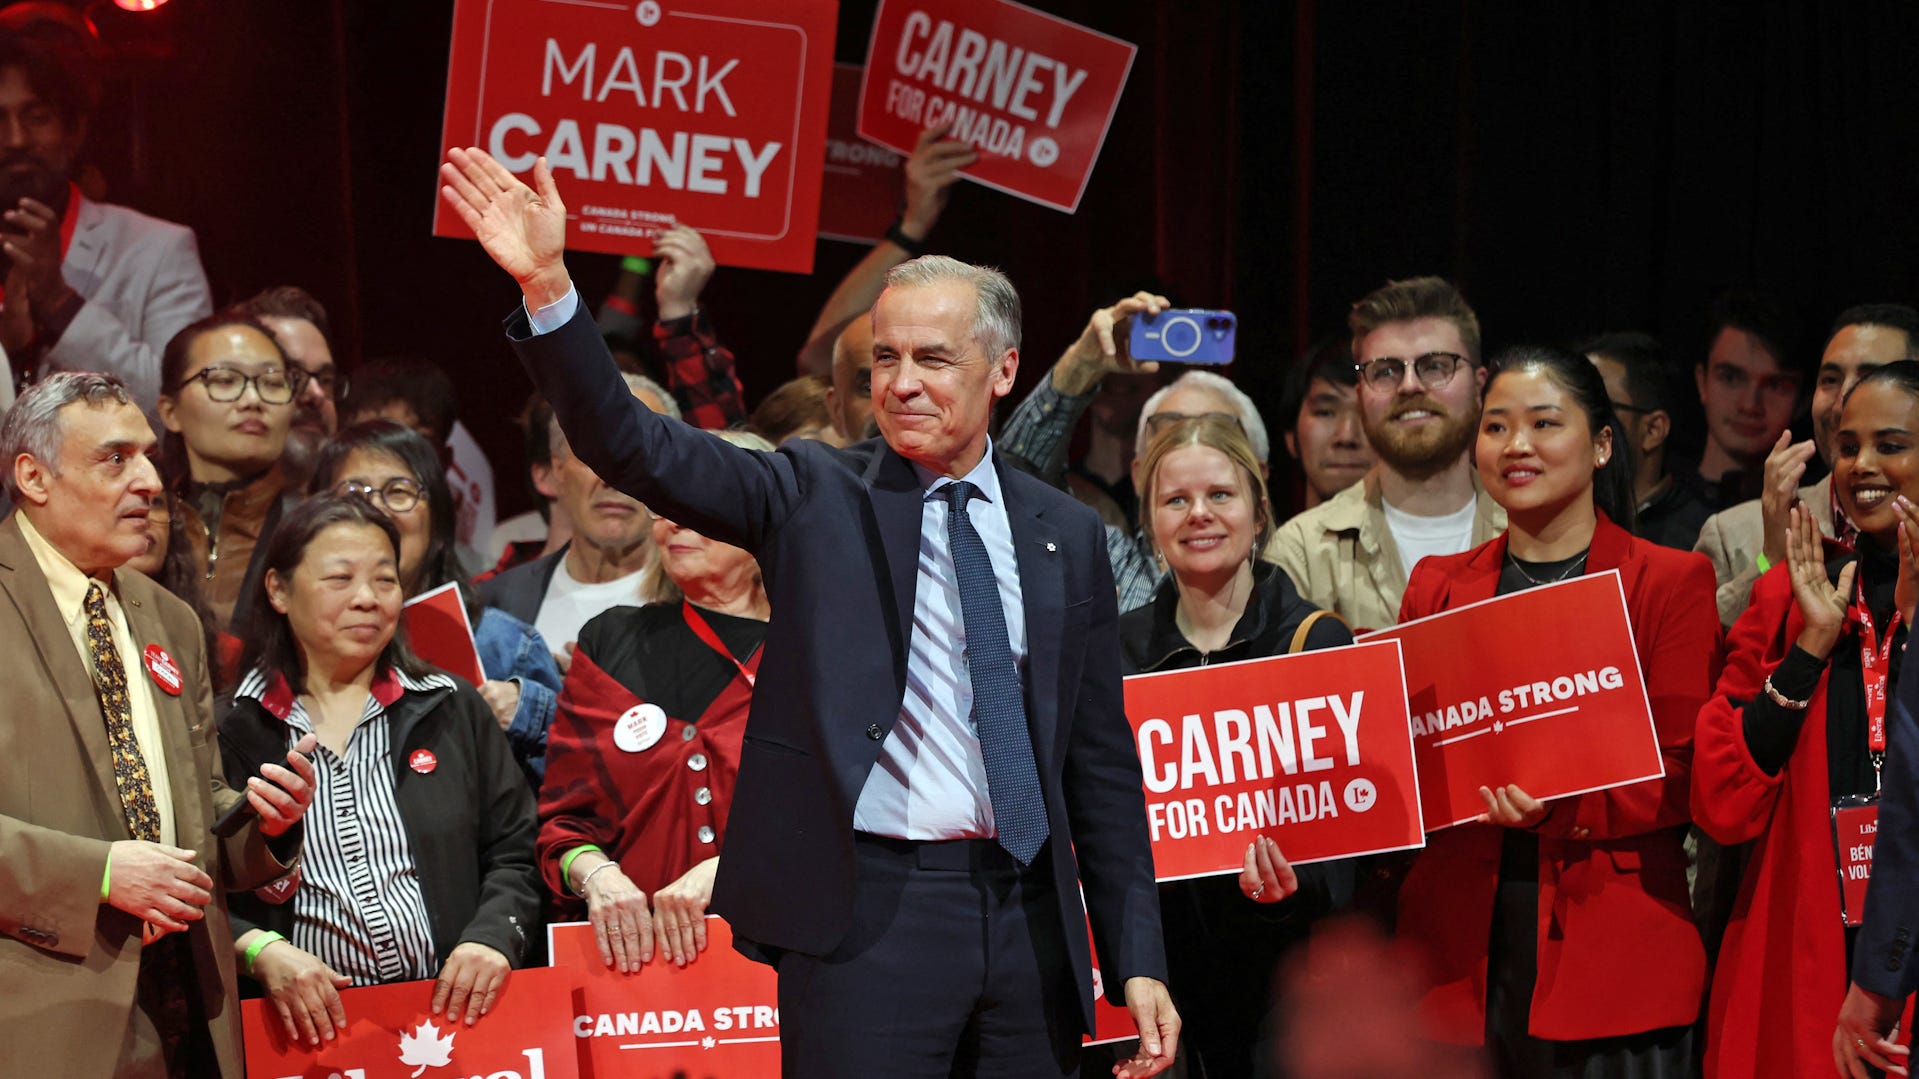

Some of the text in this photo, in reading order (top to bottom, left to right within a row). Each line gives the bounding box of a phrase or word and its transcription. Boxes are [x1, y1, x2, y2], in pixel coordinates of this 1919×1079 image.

[541, 38, 740, 117] MARK
[895, 11, 1088, 129] CARNEY
[826, 140, 900, 168] RONG
[886, 80, 1026, 161] FOR CANADA
[488, 112, 782, 198] CARNEY
[581, 204, 628, 218] CANADA
[598, 223, 643, 237] CANADA
[1411, 666, 1624, 738] ANADA STRONG
[1874, 717, 1883, 742] Liberal
[1138, 690, 1365, 794] CARNEY
[1148, 780, 1339, 842] FOR CANADA
[573, 1005, 780, 1038] CANADA STR
